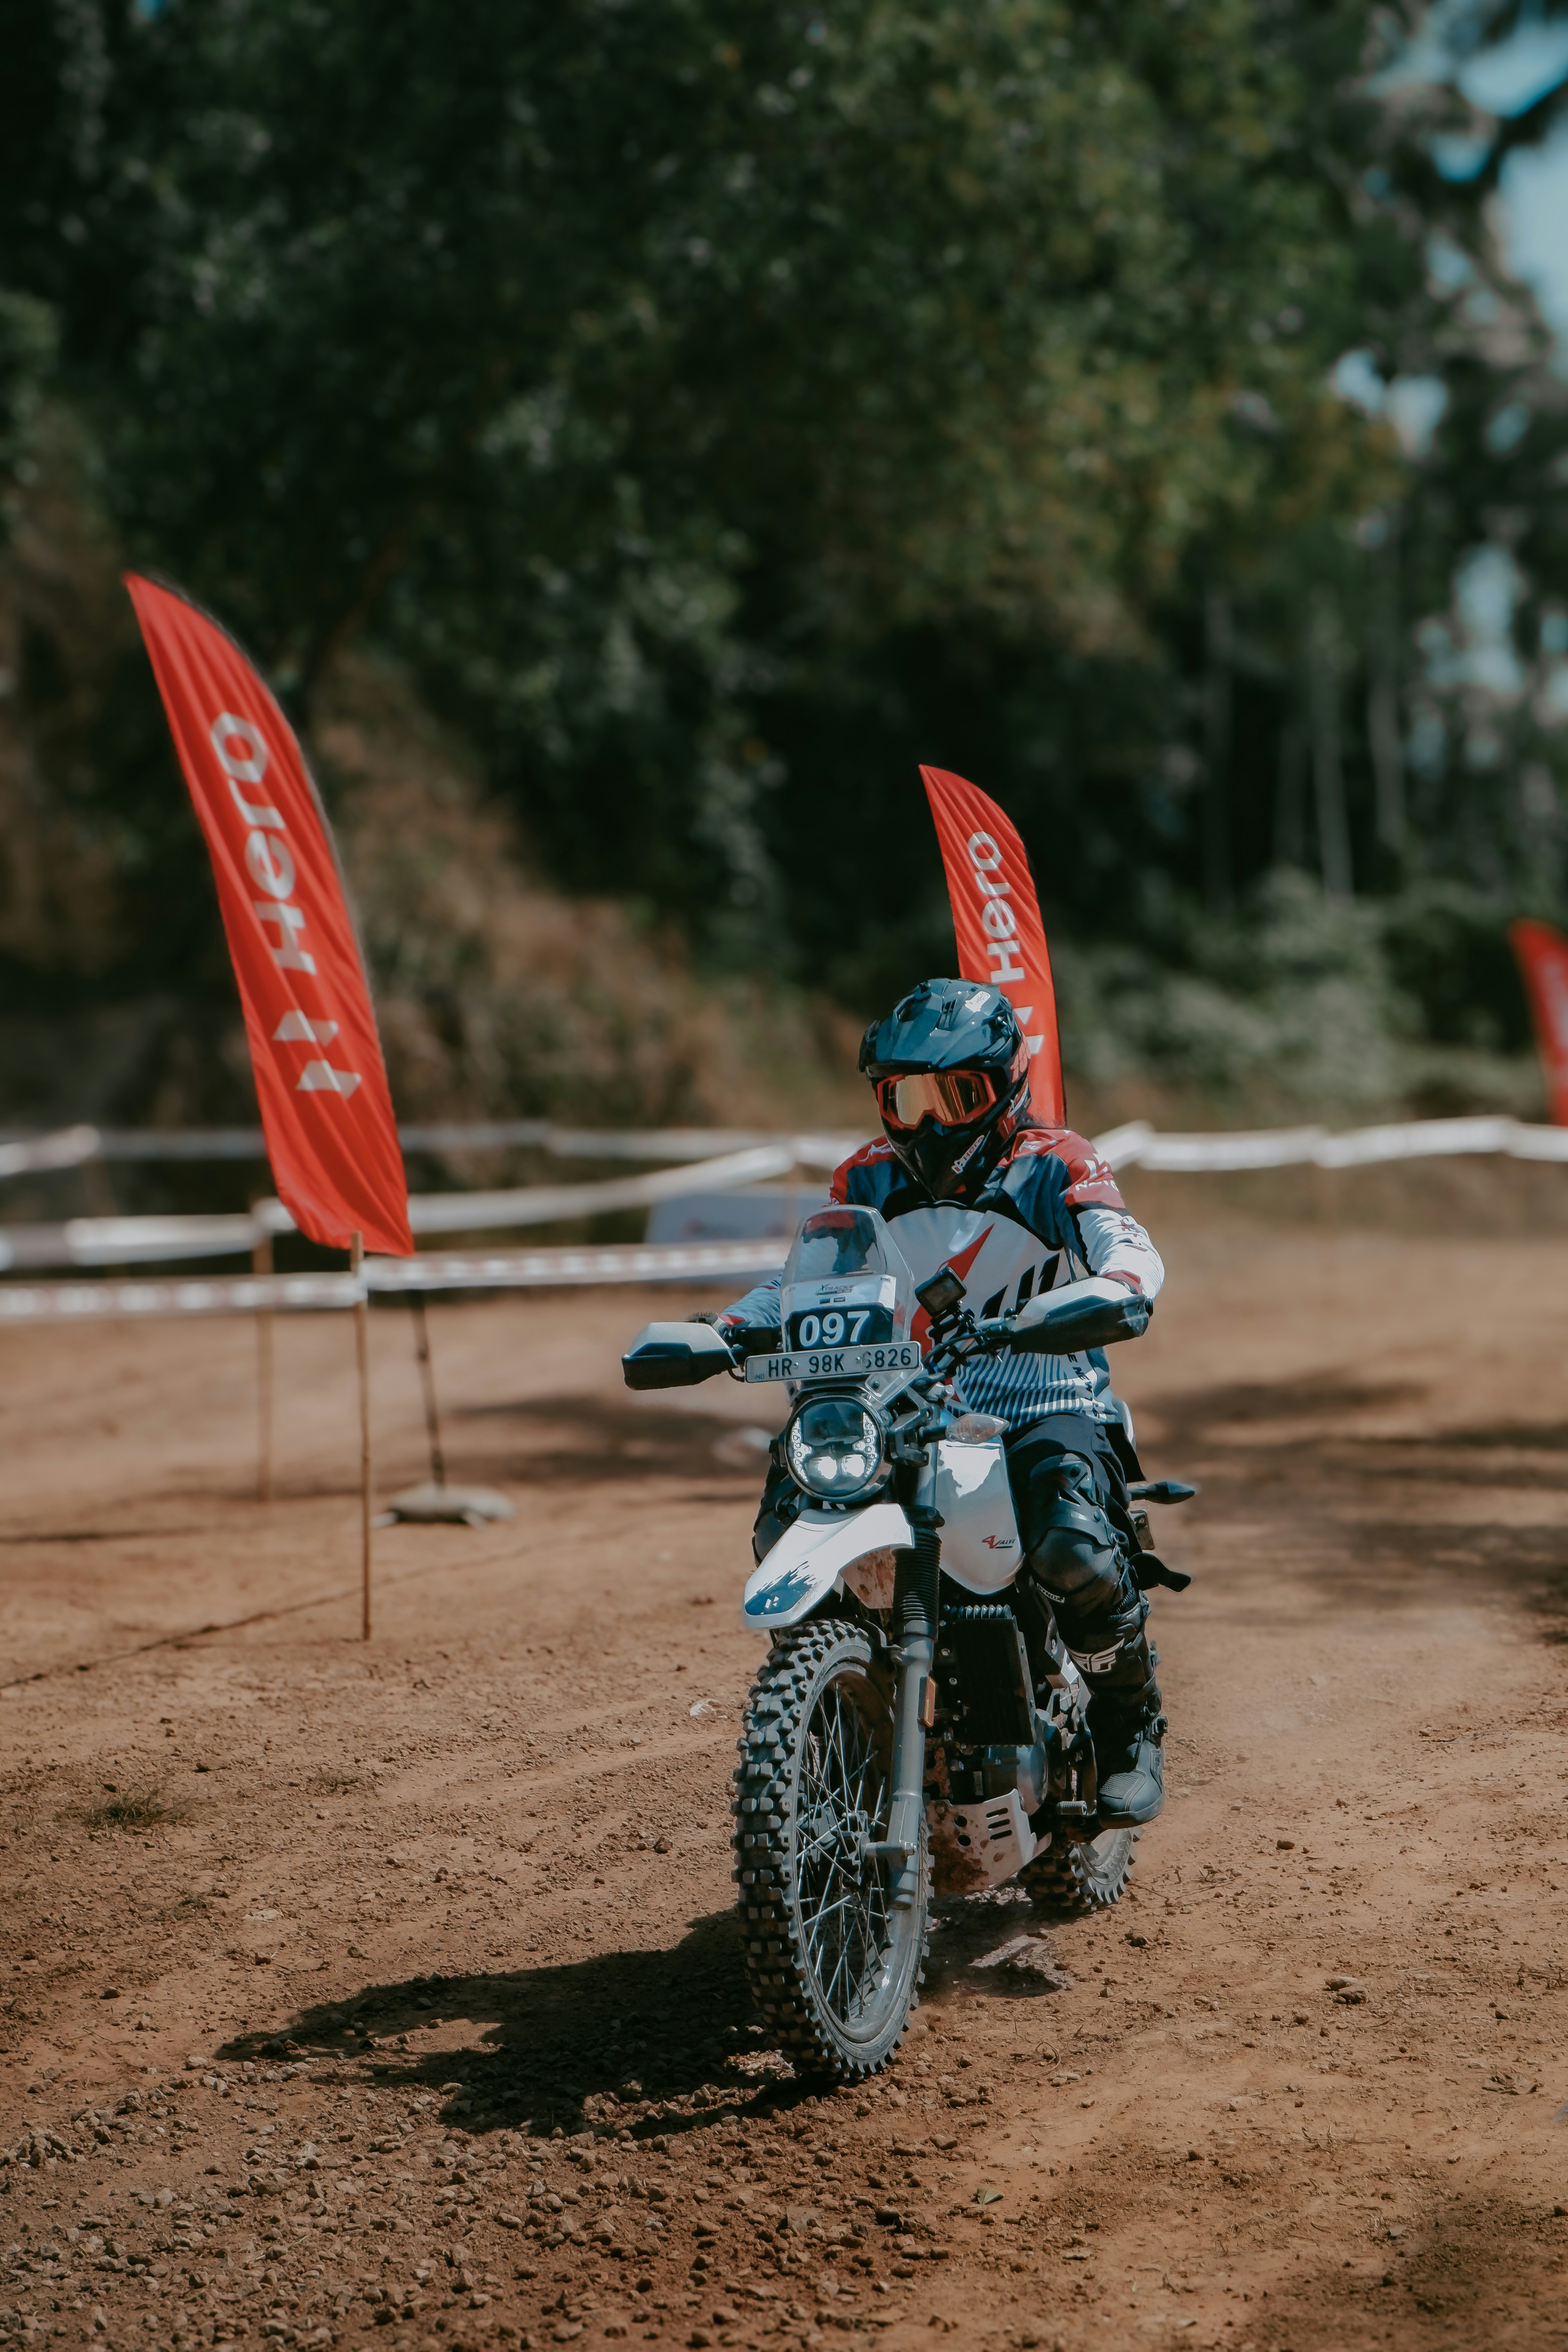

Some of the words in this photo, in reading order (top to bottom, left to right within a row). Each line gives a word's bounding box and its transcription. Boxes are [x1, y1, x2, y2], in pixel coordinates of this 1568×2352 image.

[210, 711, 318, 975] Hero
[968, 831, 1025, 984] Hero
[768, 1357, 792, 1377] HR
[809, 1353, 844, 1373] 98K
[799, 1310, 870, 1347] 097
